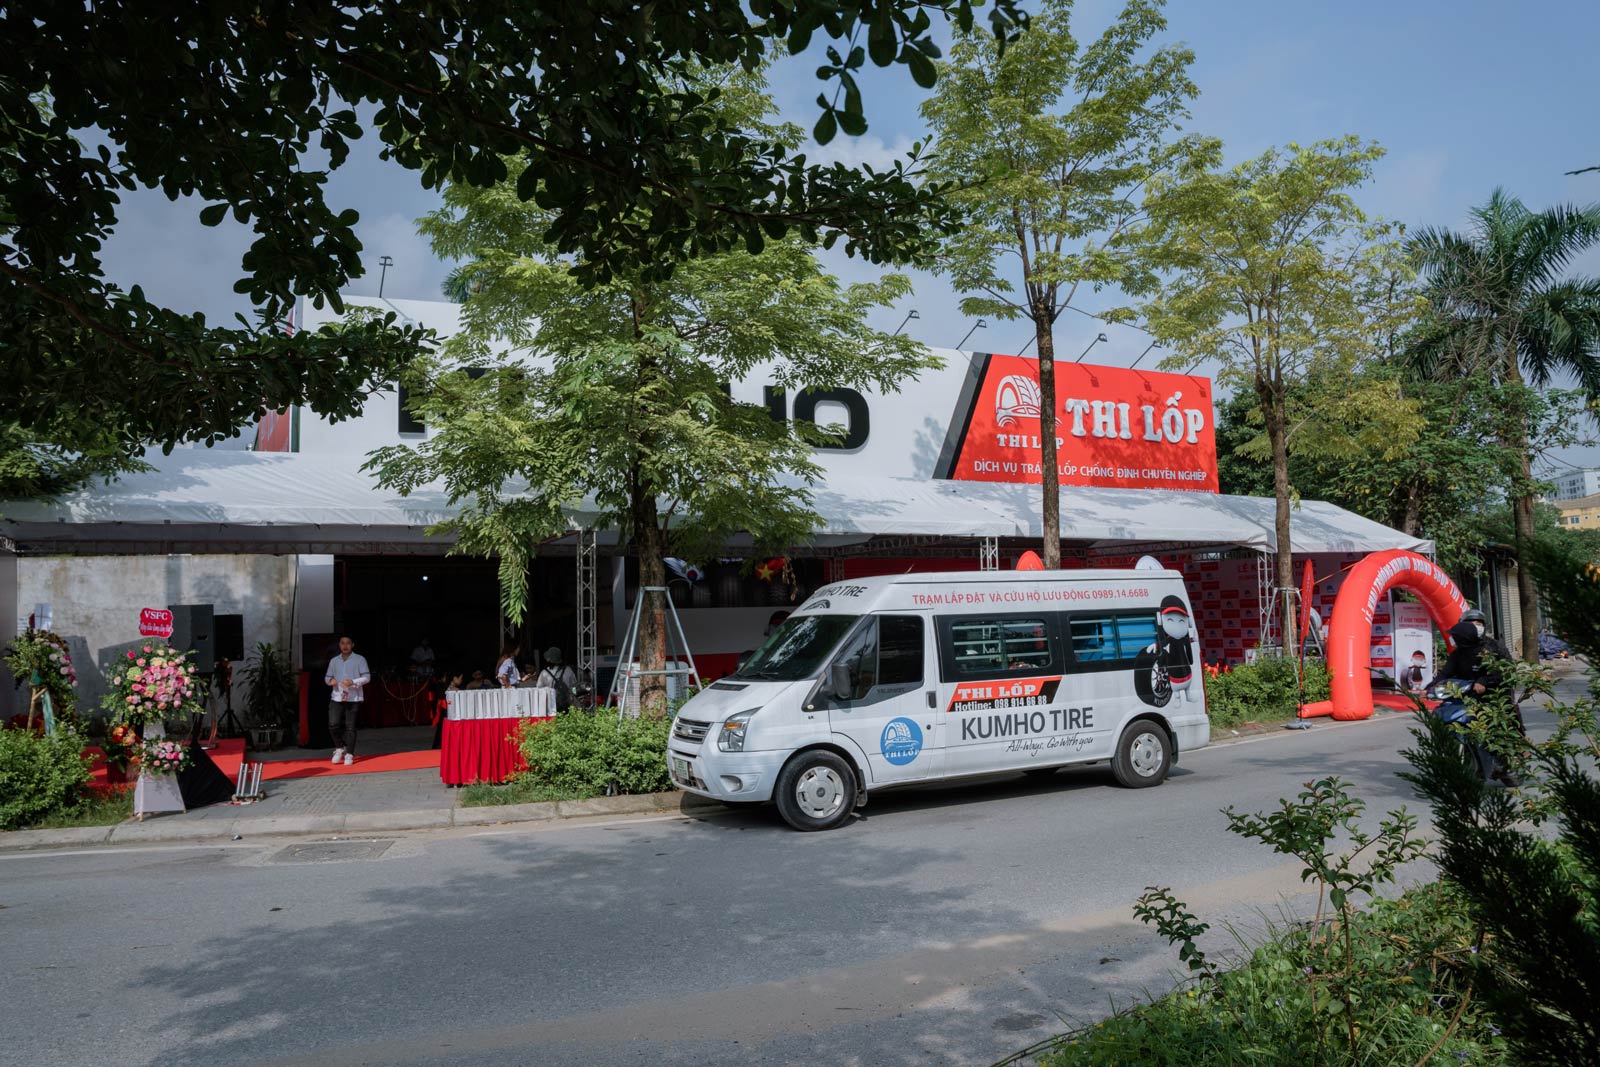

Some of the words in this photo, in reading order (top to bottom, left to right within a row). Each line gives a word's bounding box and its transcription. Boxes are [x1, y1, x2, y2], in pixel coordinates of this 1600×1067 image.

[1065, 398, 1132, 440] THI
[1141, 391, 1205, 444] LỐP
[996, 434, 1028, 448] THI
[1032, 435, 1064, 450] LP
[974, 458, 1000, 474] DỊCH
[1002, 462, 1018, 475] VỤ
[1021, 461, 1042, 474] TRÁ
[1058, 460, 1077, 476] LỐP
[1080, 461, 1114, 478] CHỐNG
[1142, 467, 1176, 480] CHUYÊN
[1178, 468, 1207, 481] NGHIỆP
[839, 585, 868, 597] TIRE
[912, 594, 943, 605] TRẠM
[945, 591, 964, 604] LẮP
[966, 592, 985, 604] ĐẶT
[989, 590, 1002, 602] VÀ
[1027, 590, 1040, 602] HỘ
[1043, 591, 1061, 601] LƯU
[1063, 589, 1090, 602] ĐỘNG
[1092, 588, 1149, 599] 0989.14.6688
[144, 610, 168, 621] VSFC
[957, 687, 992, 699] THI
[998, 682, 1037, 697] LỐP
[955, 701, 992, 711] Hotline:
[994, 699, 1009, 709] 098
[1011, 697, 1023, 707] 914
[961, 711, 1046, 741] KUMHO
[1049, 706, 1094, 732] TIRE
[1046, 736, 1060, 749] Go
[1076, 736, 1094, 752] you
